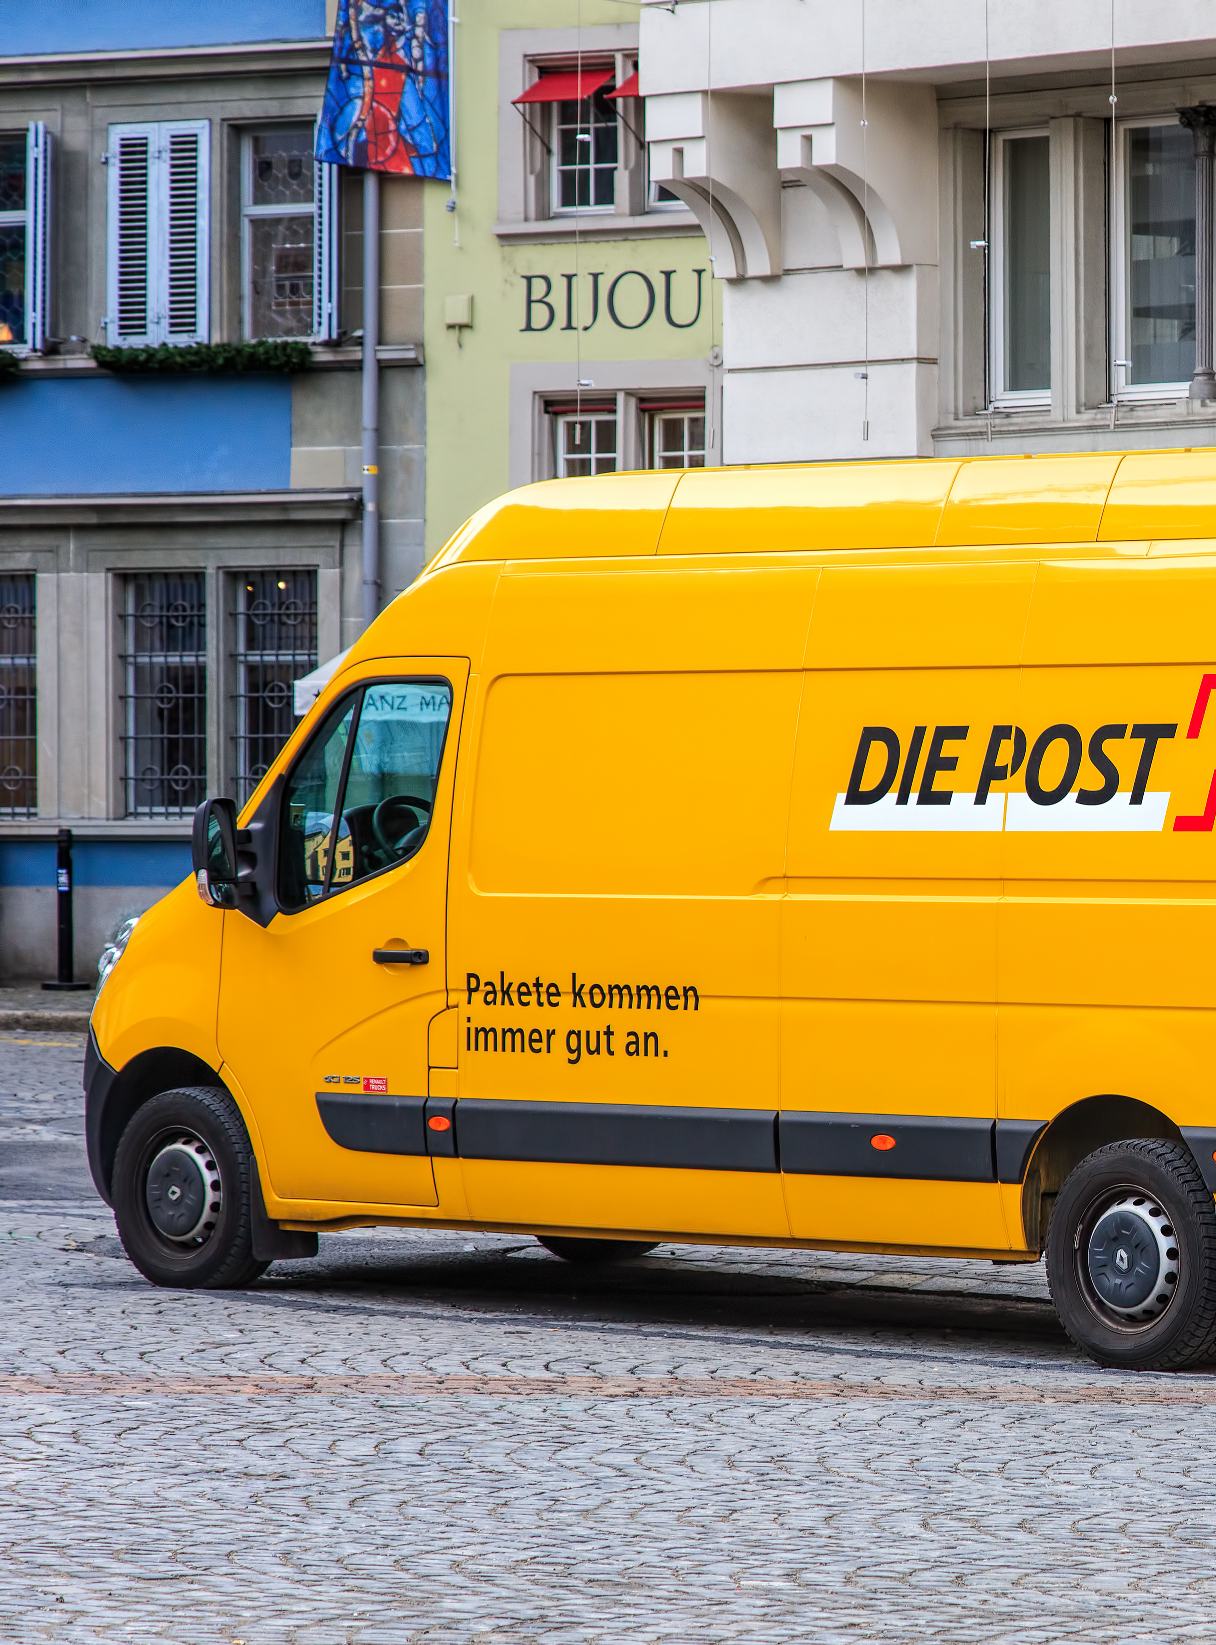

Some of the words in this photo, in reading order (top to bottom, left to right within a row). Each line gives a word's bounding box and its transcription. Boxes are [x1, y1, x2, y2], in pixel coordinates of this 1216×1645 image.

[519, 268, 706, 332] BIJOU
[844, 725, 970, 806] DIE
[973, 723, 1179, 807] POST
[465, 970, 562, 1008] Pakete
[571, 972, 700, 1011] kommen
[465, 1016, 556, 1054] immer
[565, 1024, 615, 1065] gut
[624, 1030, 669, 1058] an.
